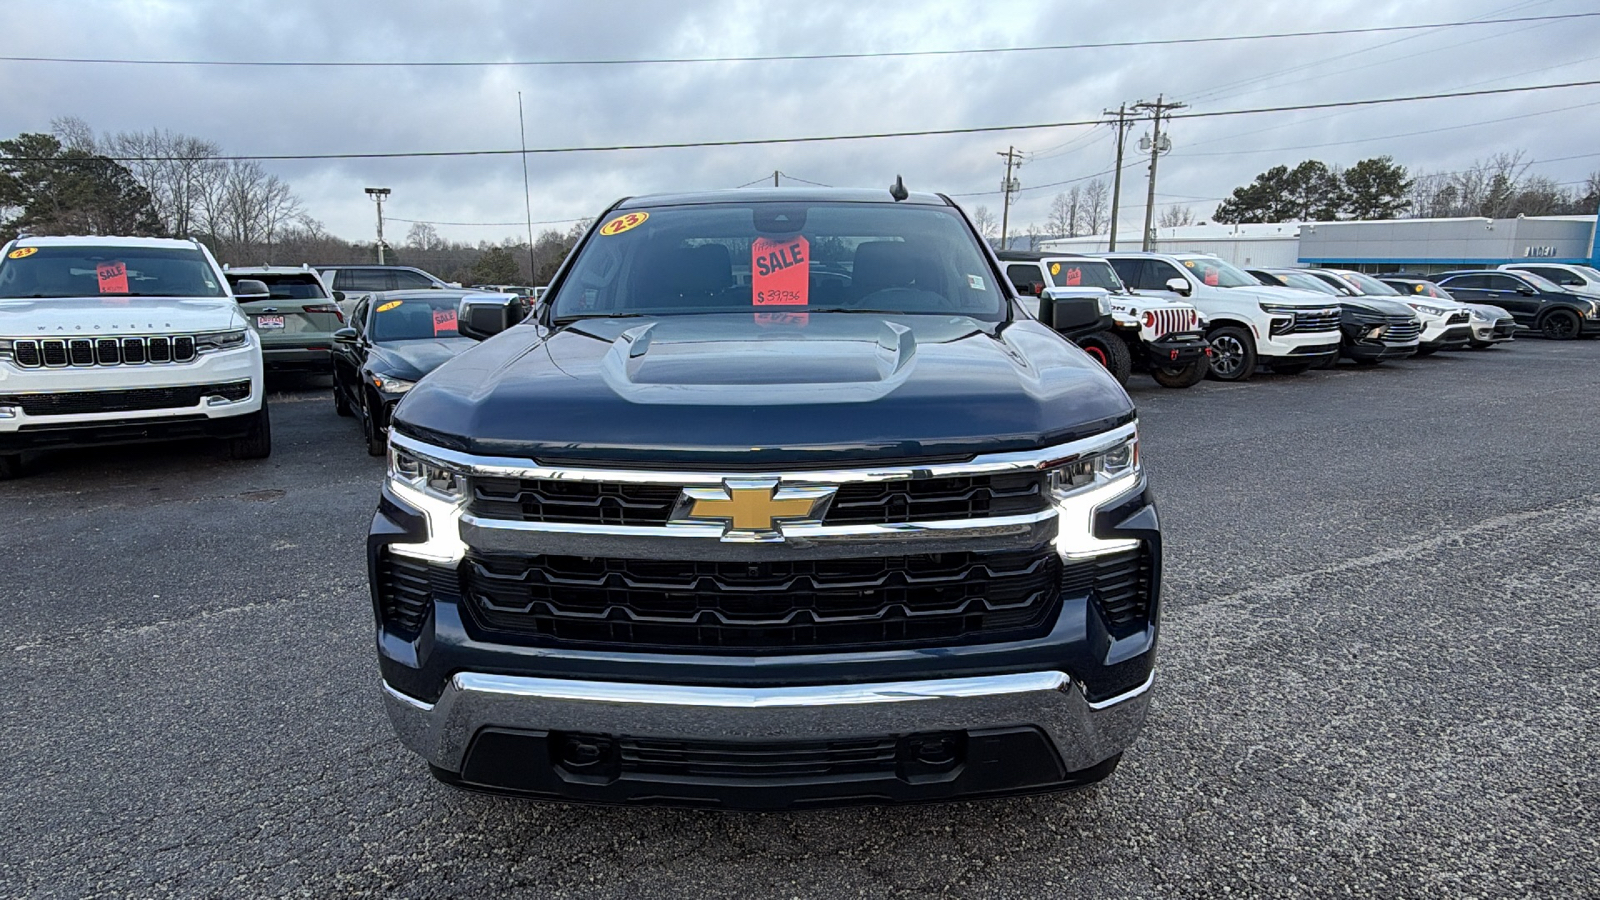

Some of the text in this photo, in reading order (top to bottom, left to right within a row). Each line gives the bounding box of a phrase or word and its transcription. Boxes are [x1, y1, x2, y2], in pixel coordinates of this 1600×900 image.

[610, 214, 639, 233] 23
[15, 247, 32, 257] 23
[756, 243, 805, 276] SALE
[99, 265, 124, 281] SALE
[434, 311, 455, 325] SALE
[37, 322, 171, 331] WAGONEER
